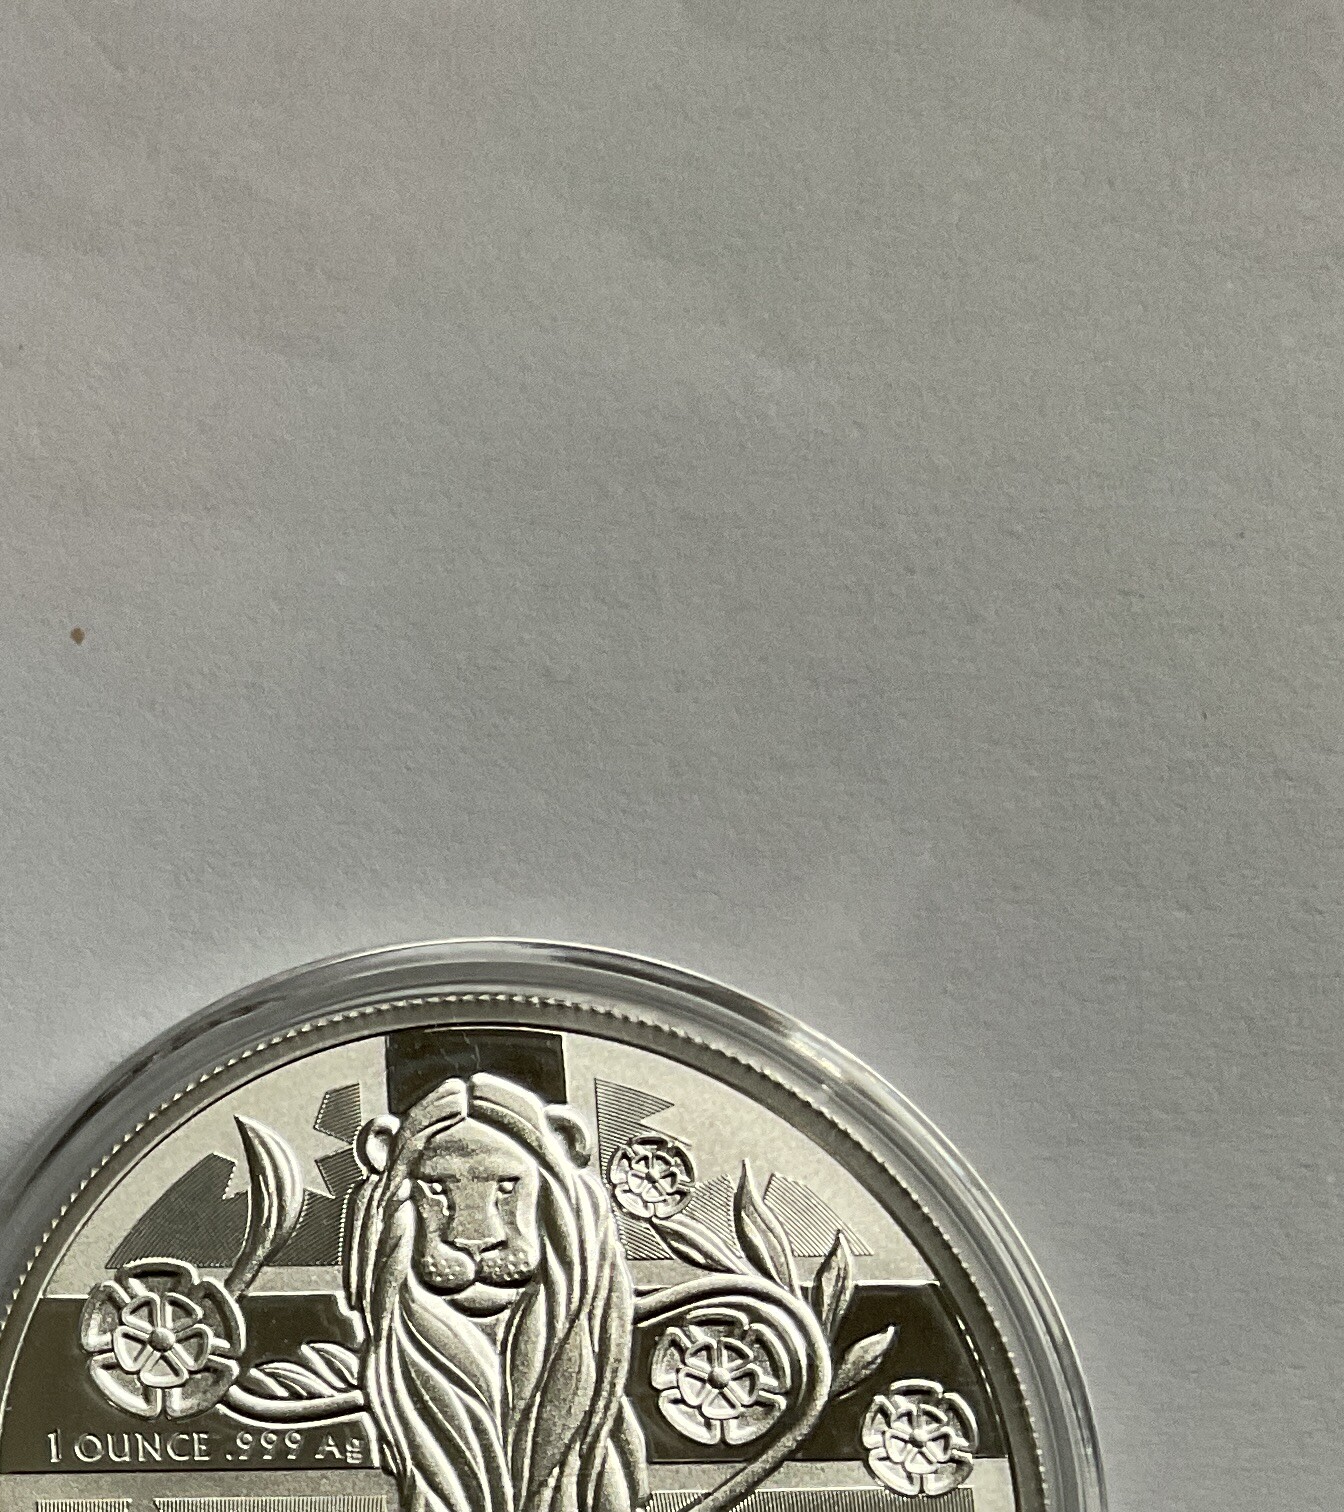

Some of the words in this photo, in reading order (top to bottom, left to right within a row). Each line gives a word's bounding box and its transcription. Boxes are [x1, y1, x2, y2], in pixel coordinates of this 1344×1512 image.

[47, 1428, 62, 1463] 1
[74, 1430, 211, 1463] OUNCE
[225, 1430, 302, 1462] .999
[315, 1434, 364, 1464] Ag
